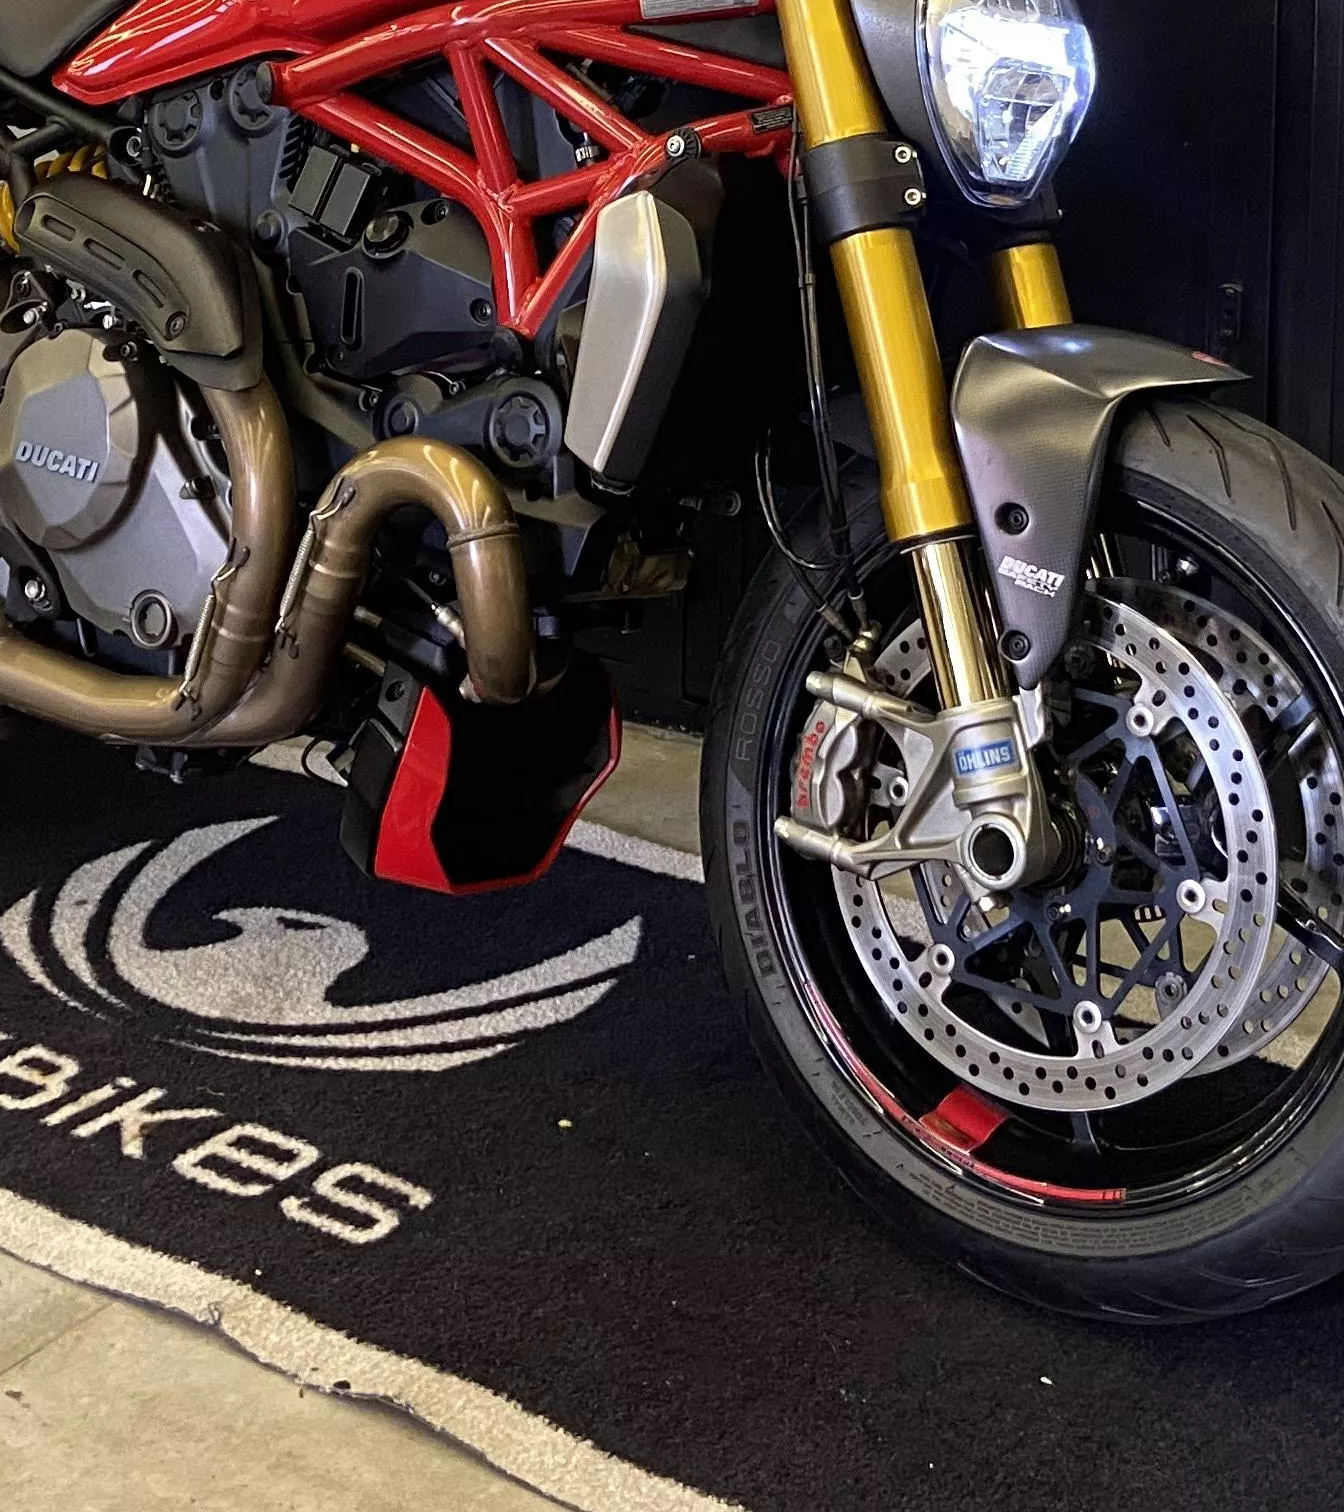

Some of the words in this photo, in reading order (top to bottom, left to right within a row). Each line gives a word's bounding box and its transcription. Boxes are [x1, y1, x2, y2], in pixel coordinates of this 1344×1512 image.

[16, 440, 99, 482] DUCATI
[1000, 555, 1065, 587] DUCATI
[736, 640, 782, 761] ROSSO
[733, 821, 777, 977] DIABLO
